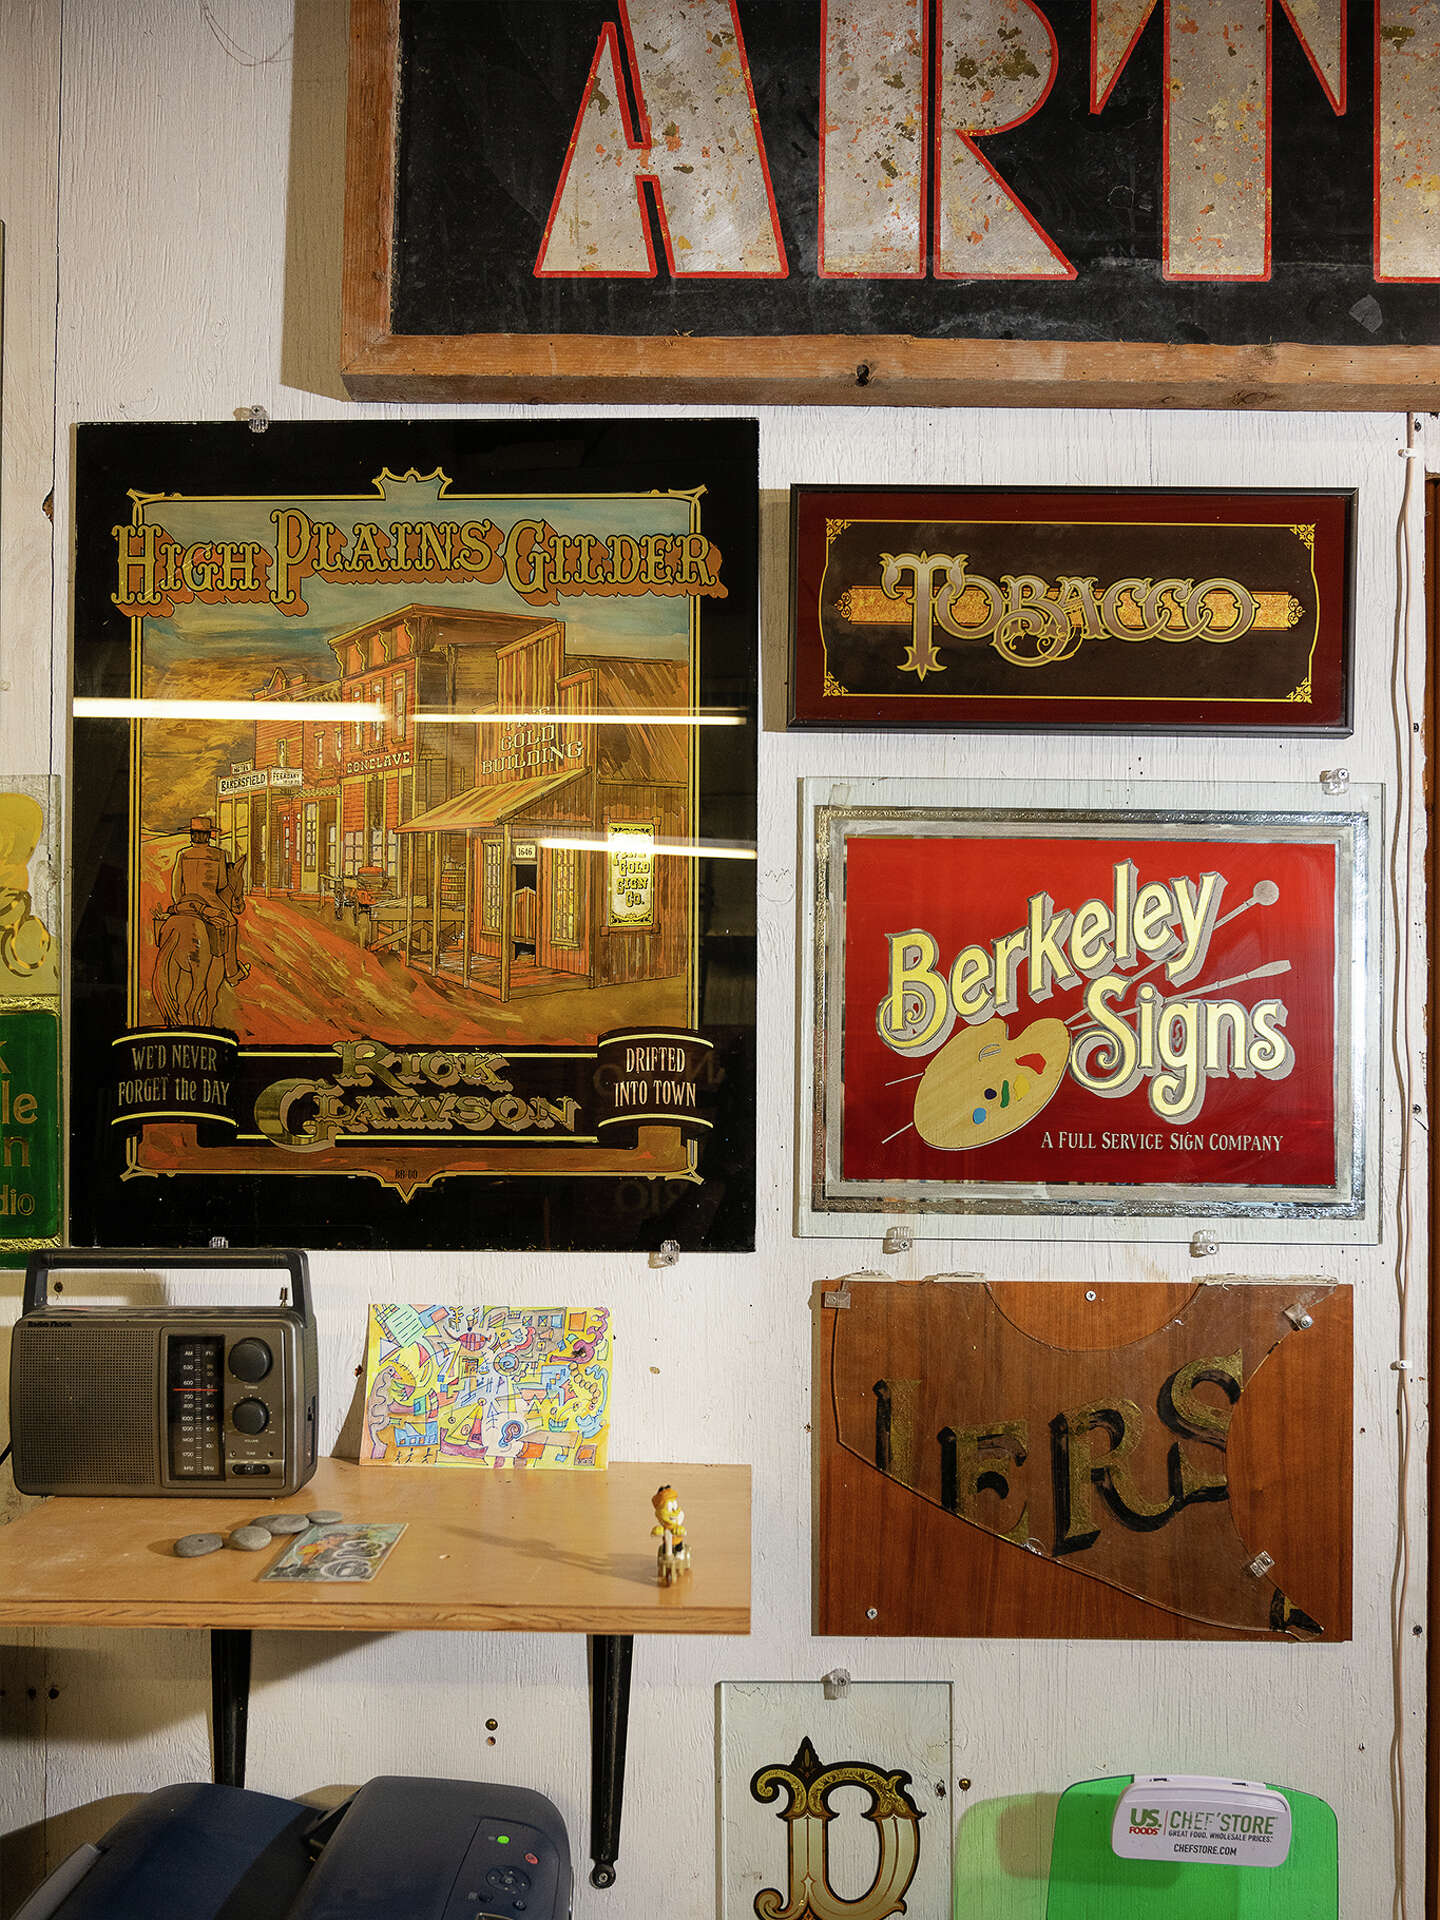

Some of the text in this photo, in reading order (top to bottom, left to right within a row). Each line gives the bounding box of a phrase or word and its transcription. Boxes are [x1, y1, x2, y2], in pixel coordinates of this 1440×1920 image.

[111, 508, 726, 614] HIGH PLAINS GILDER
[880, 550, 1260, 682] TOBACCO
[501, 724, 555, 751] GOLD
[346, 751, 411, 774] CONCLAVE
[481, 740, 585, 775] BUILDING
[220, 773, 266, 792] BAKERSFIELD
[619, 860, 650, 876] GOLD
[616, 877, 648, 895] SIGN
[875, 858, 1226, 1058] Berkeley
[131, 1045, 217, 1072] WE'D NEVER
[625, 1046, 686, 1074] DRIFTED
[1070, 974, 1296, 1124] Signs
[118, 1077, 230, 1107] FORGET the DAY
[614, 1080, 697, 1107] INTO TOWN
[1041, 1132, 1284, 1152] A FULL SERVICE SIGN COMPANY
[1130, 1808, 1162, 1827] US.
[1168, 1829, 1188, 1838] GREAT
[1209, 1832, 1246, 1842] WHOLESALE
[1173, 1843, 1237, 1856] CHEFSTORE.COM
